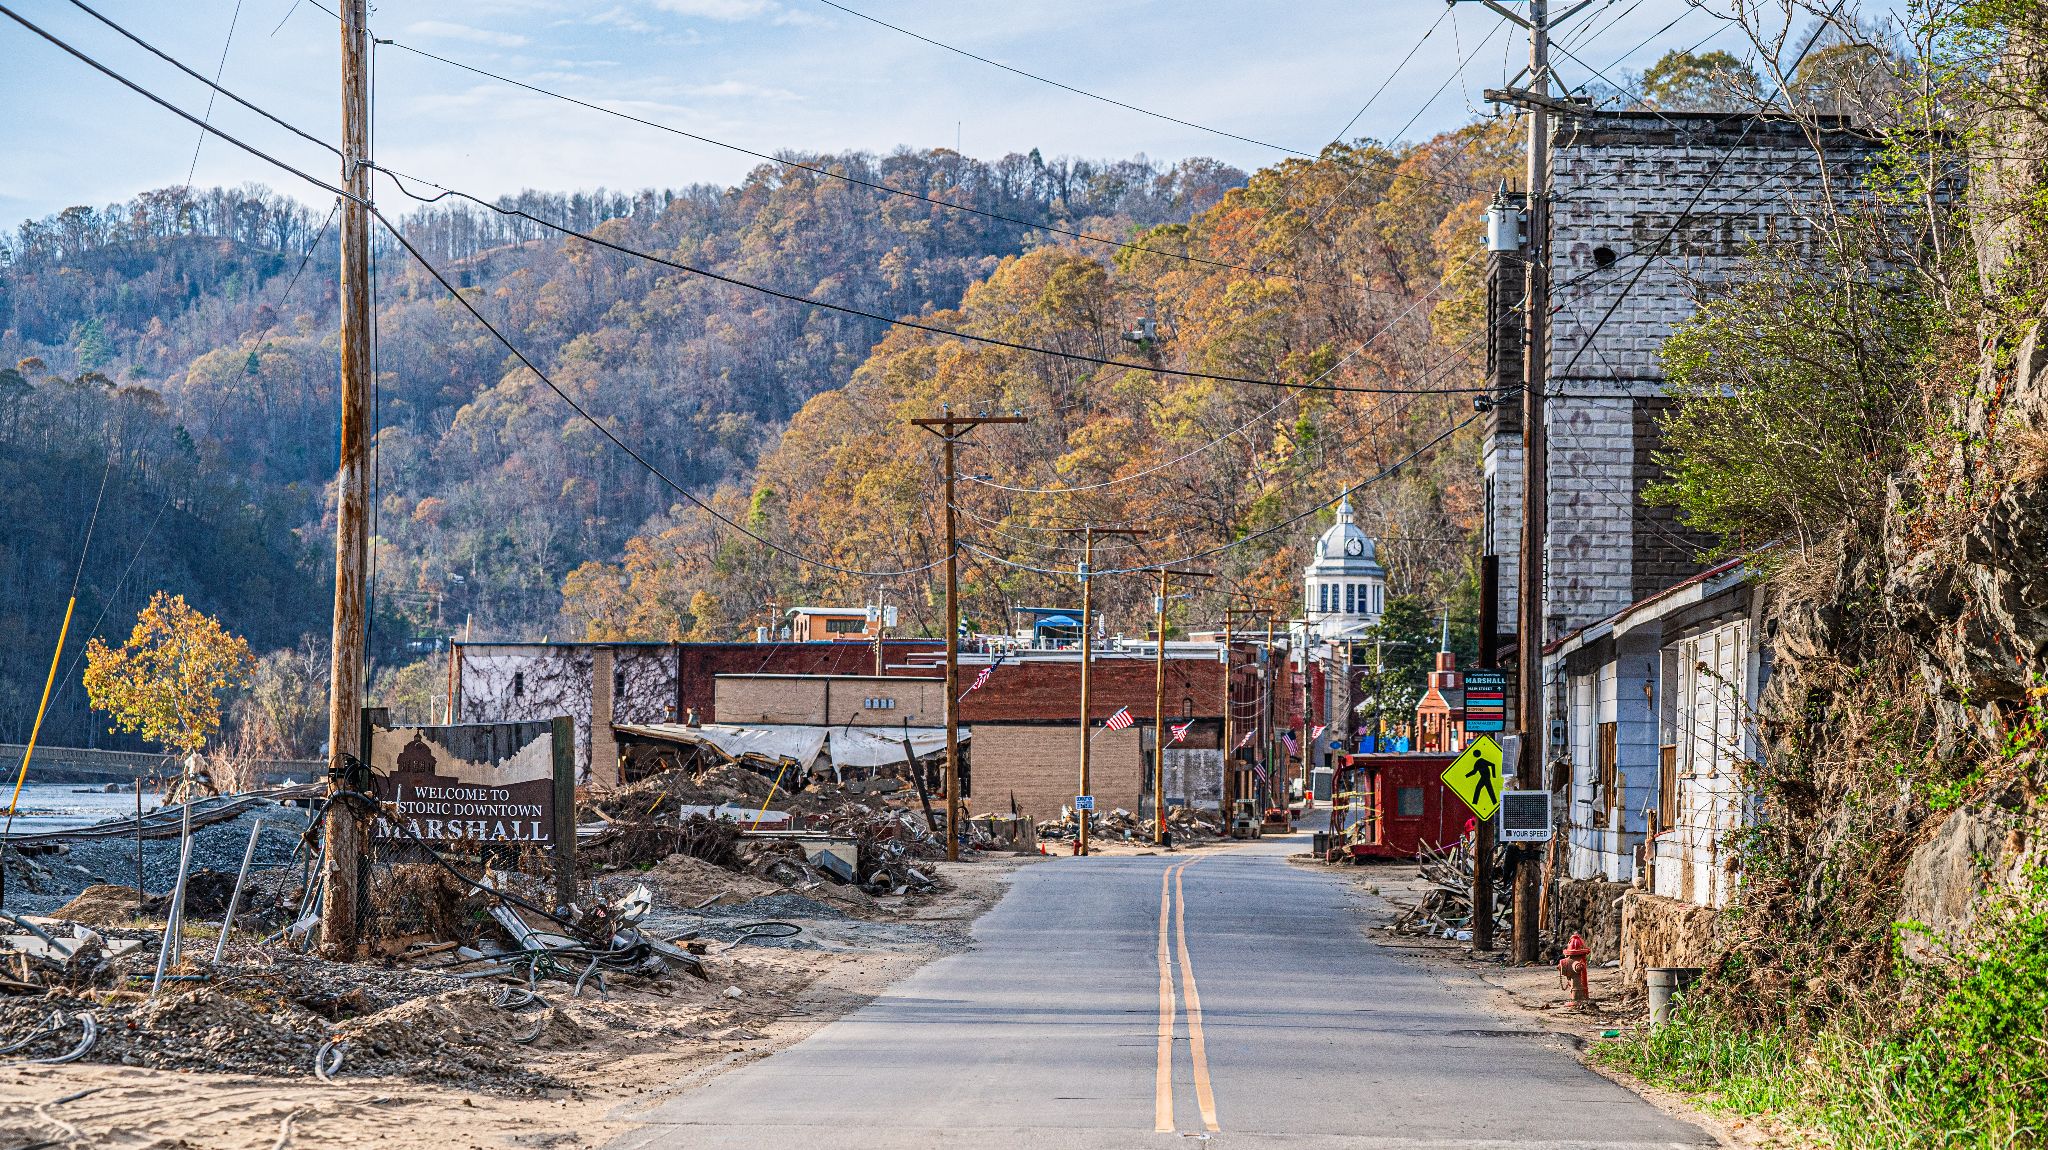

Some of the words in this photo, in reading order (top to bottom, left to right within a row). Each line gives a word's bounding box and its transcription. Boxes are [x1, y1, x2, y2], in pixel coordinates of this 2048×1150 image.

[414, 786, 487, 801] WELCOME
[490, 789, 510, 801] TO
[394, 801, 451, 815] STORIC
[454, 803, 542, 817] DOWNTOWN
[375, 817, 549, 841] MARSHALL
